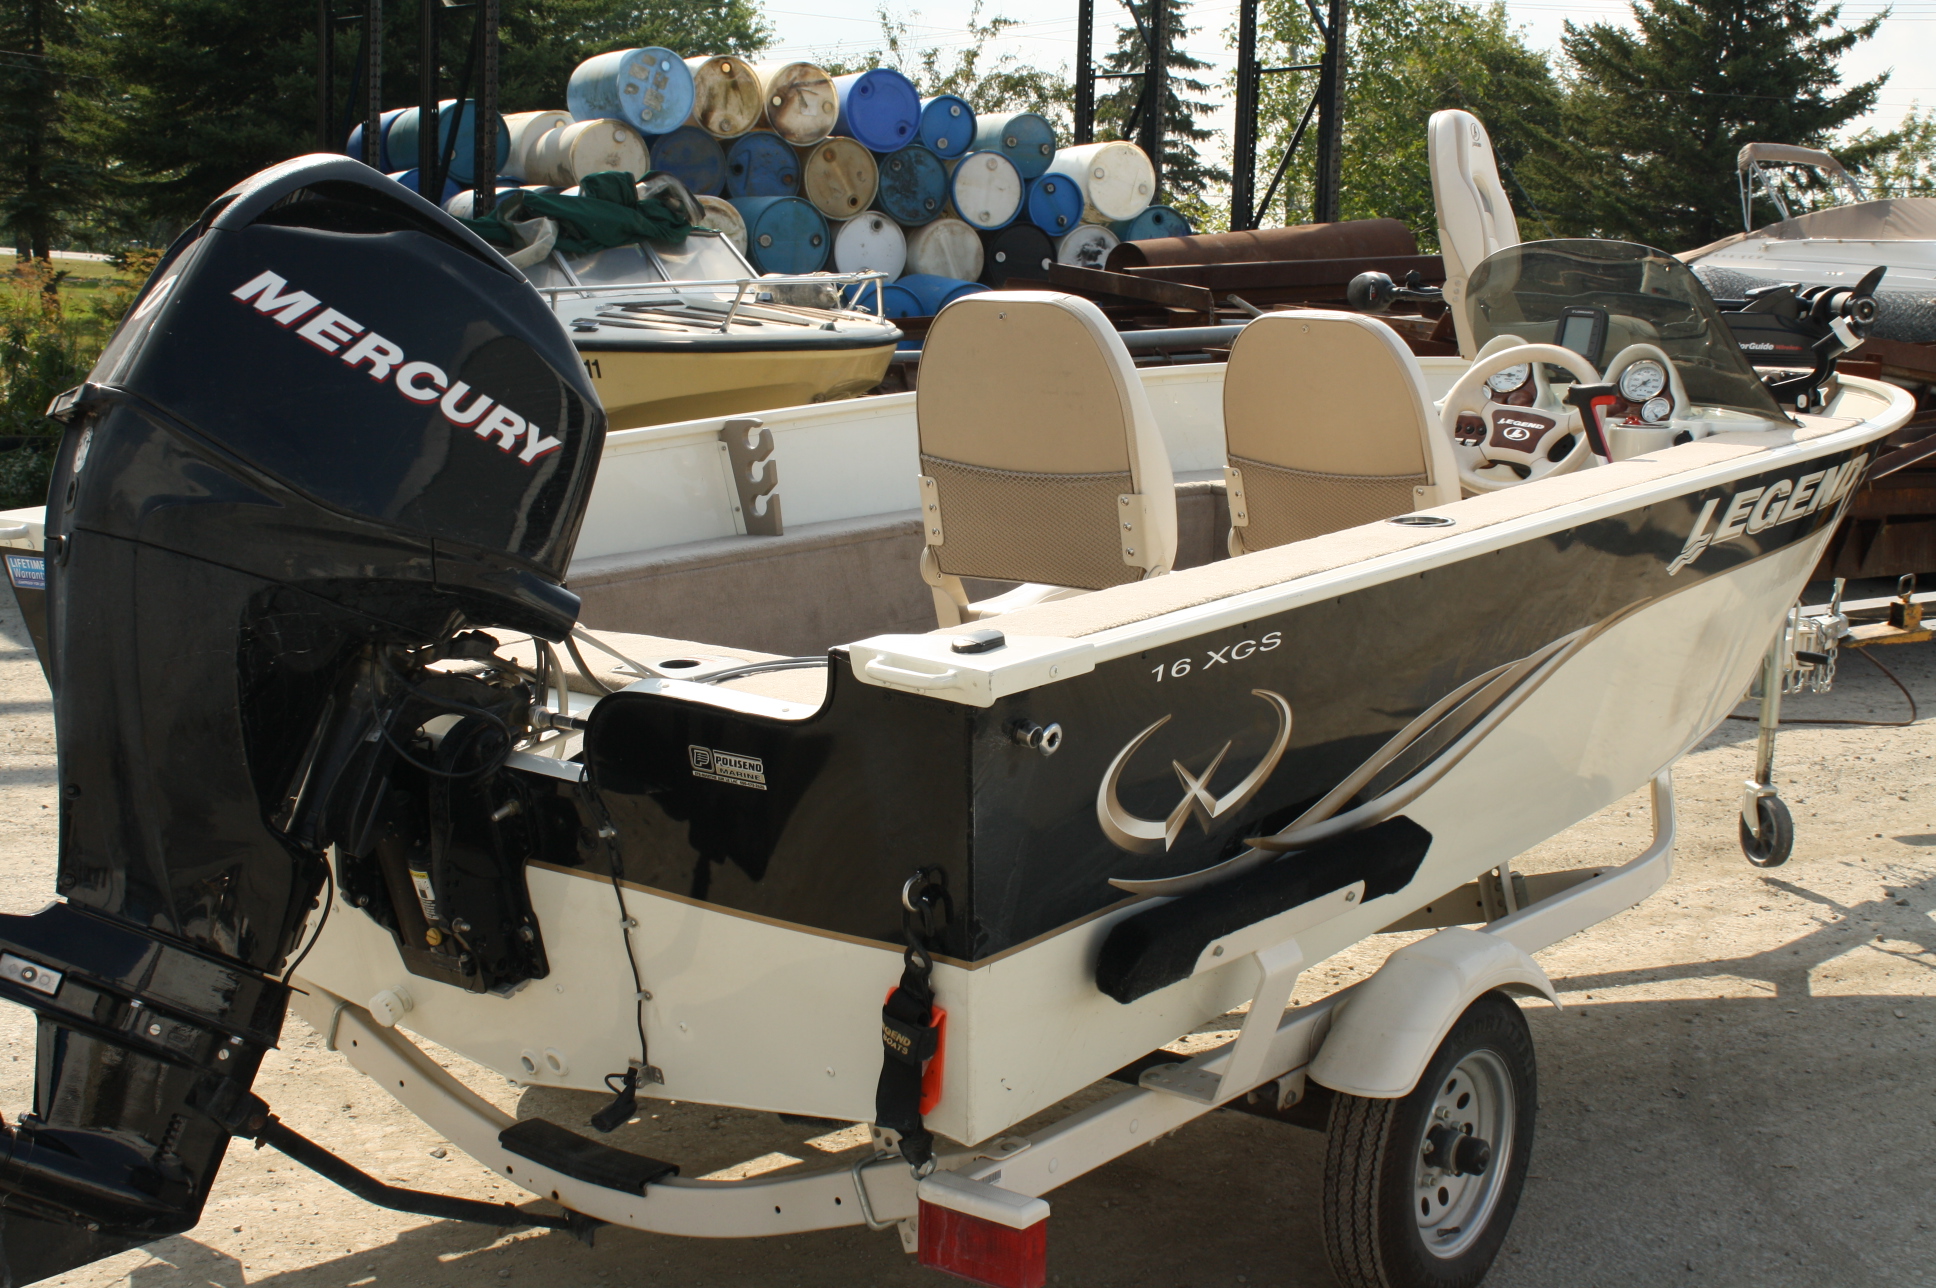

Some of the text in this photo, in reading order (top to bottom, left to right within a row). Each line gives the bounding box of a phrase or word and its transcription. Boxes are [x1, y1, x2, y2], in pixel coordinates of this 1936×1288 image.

[231, 270, 562, 465] MERCURY
[1497, 417, 1545, 430] LEGEND
[1666, 452, 1869, 576] LEGEND
[10, 558, 45, 570] LIFETIME
[14, 568, 45, 580] Warrant
[1151, 631, 1281, 682] 16 XGS
[715, 755, 762, 773] POLISEND
[719, 768, 761, 781] MARINE
